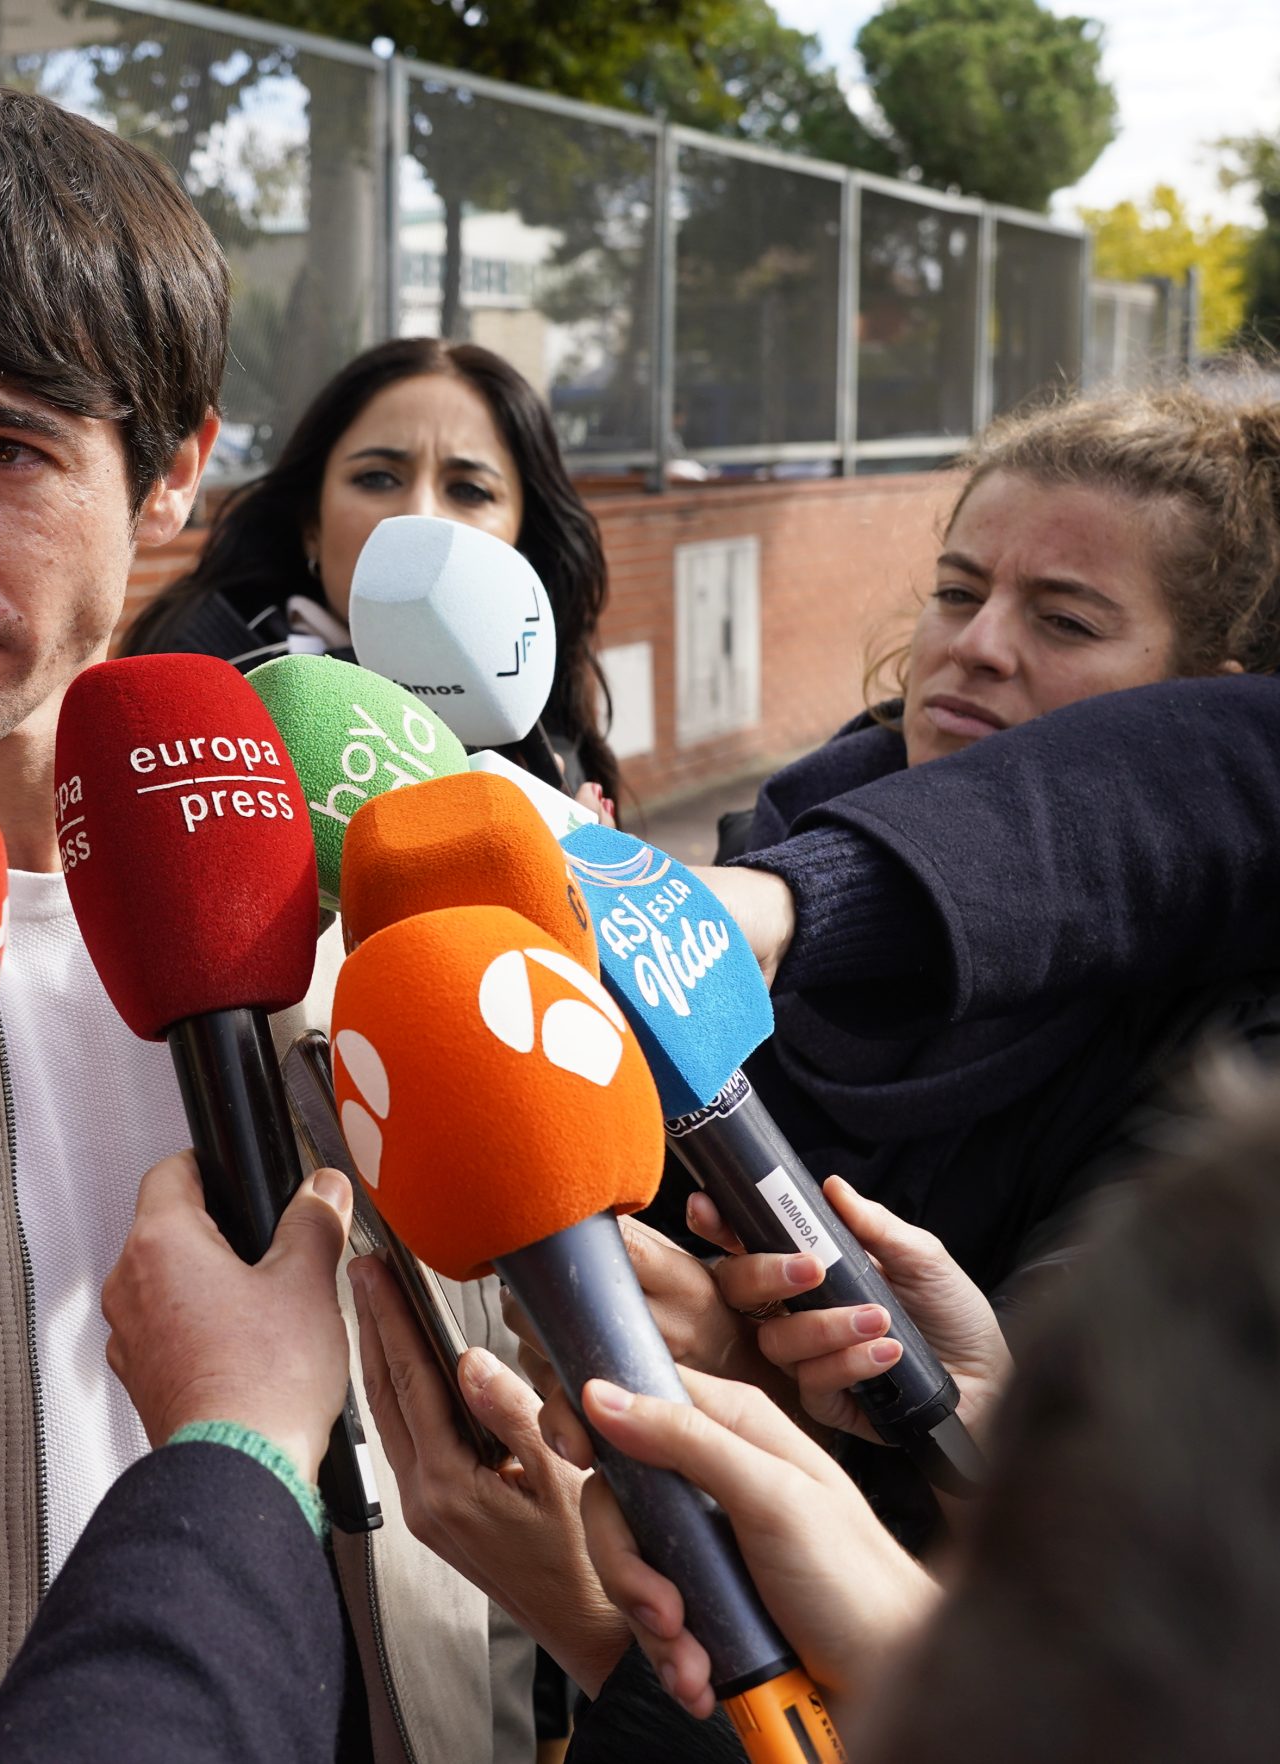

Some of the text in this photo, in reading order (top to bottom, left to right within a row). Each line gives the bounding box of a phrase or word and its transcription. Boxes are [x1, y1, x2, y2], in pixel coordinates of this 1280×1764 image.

[130, 736, 280, 771] europa
[309, 704, 388, 825] hoy
[180, 789, 294, 833] press
[634, 917, 730, 1017] Vida
[778, 1193, 819, 1248] MM09A
